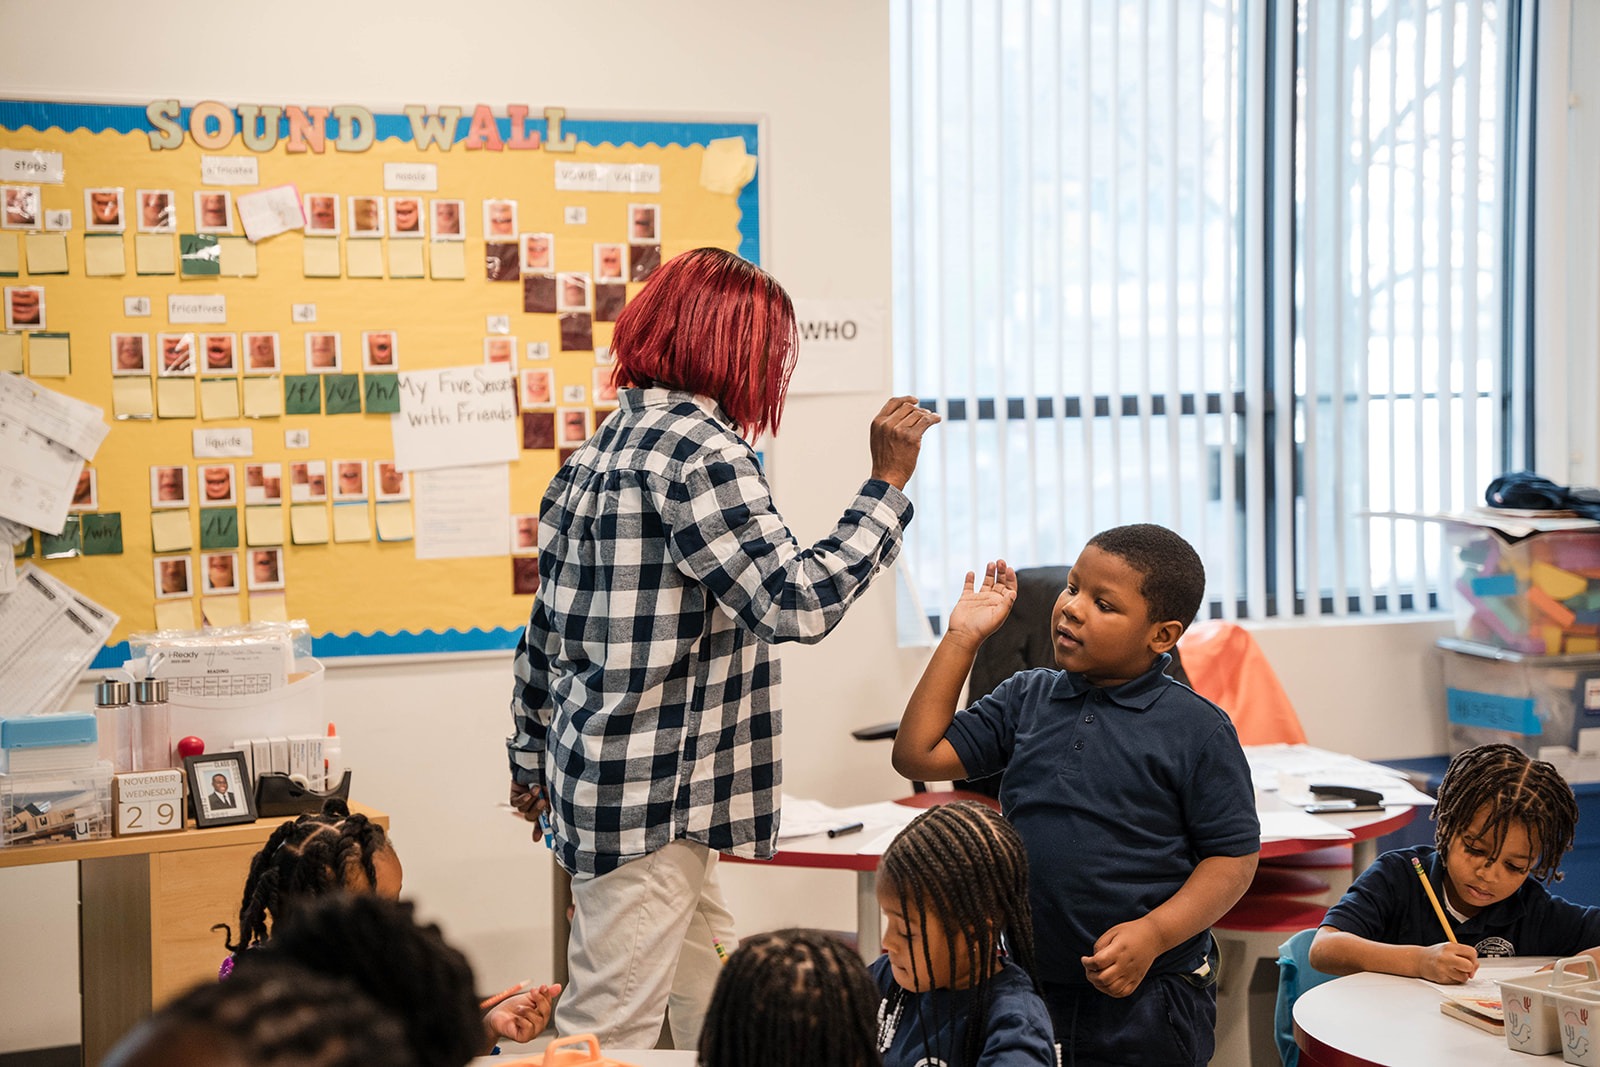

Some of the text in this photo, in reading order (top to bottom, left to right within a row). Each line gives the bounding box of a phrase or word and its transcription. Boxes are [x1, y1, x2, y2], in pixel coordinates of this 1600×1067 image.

[146, 100, 577, 153] SOUND WALL
[14, 160, 48, 173] stops
[171, 303, 224, 314] fricatives
[799, 320, 858, 340] WHO
[397, 376, 427, 404] My
[439, 371, 473, 394] Five
[456, 401, 512, 424] Friends
[205, 431, 241, 448] liquids
[169, 651, 199, 659] i-Ready
[123, 775, 176, 786] NOVEMBER
[125, 787, 176, 798] WEDNESDAY
